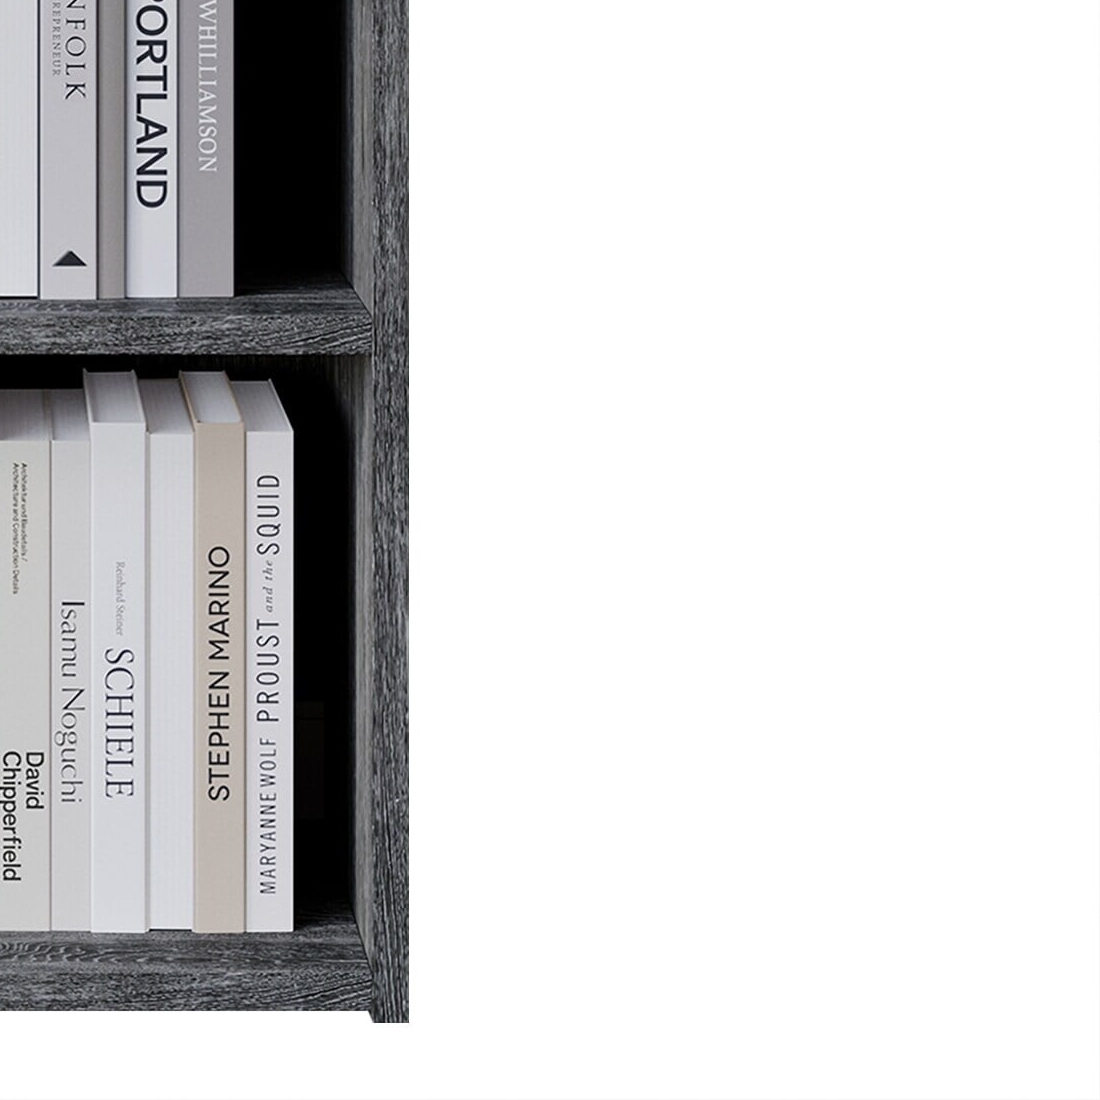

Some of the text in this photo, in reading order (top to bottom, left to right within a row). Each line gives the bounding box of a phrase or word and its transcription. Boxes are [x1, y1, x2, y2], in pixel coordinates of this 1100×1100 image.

[199, 0, 217, 171] WHILLIAMSON
[116, 562, 126, 636] Reinhard Steiner
[208, 547, 229, 800] STEPHEN MARINO
[256, 476, 281, 721] PROUST and the SQUID
[56, 602, 85, 802] Isamu Noguchi
[105, 649, 134, 797] SCHIELE
[0, 751, 21, 880] Chipperfield
[26, 752, 44, 809] David
[260, 738, 276, 893] MARYANNE WOLF
